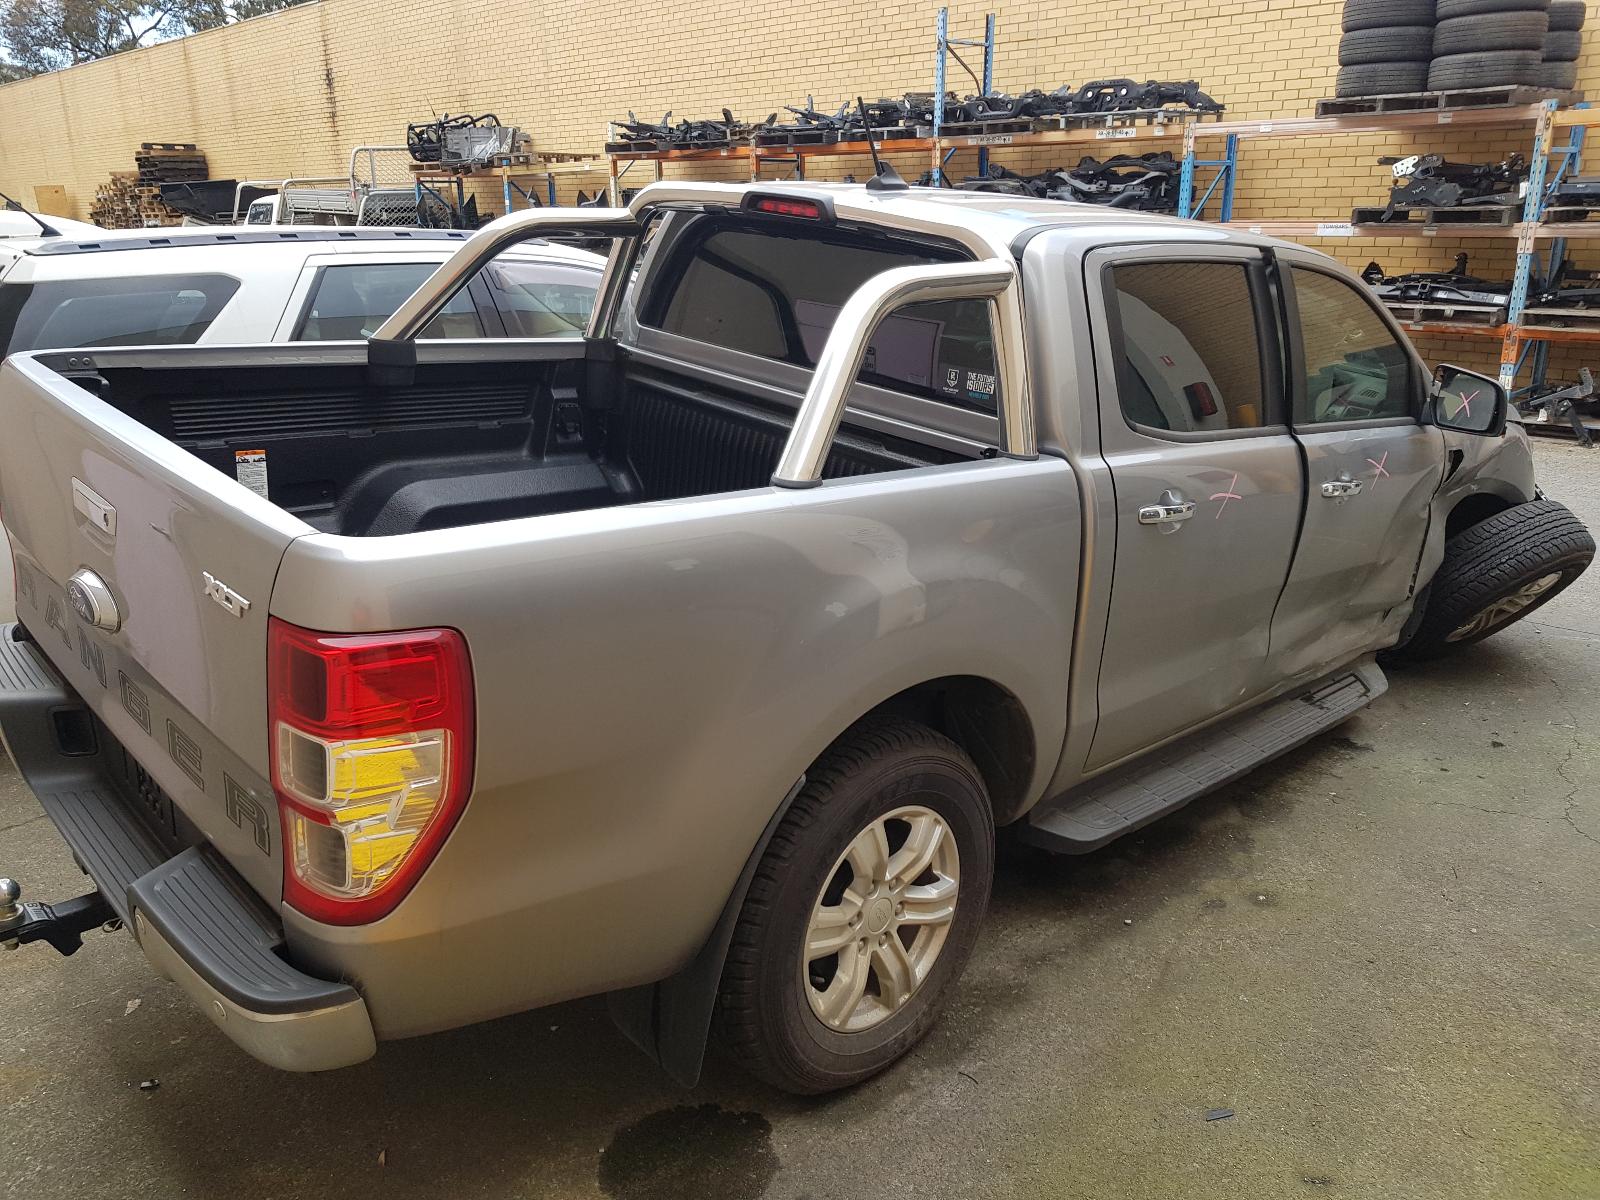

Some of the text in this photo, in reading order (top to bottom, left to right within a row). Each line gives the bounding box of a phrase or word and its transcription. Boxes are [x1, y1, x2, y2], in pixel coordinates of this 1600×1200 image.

[966, 380, 974, 390] IS
[973, 381, 994, 394] OURS
[967, 371, 977, 381] THE
[977, 373, 996, 384] FUTURE
[202, 571, 251, 618] XLT
[18, 562, 271, 857] RANGER
